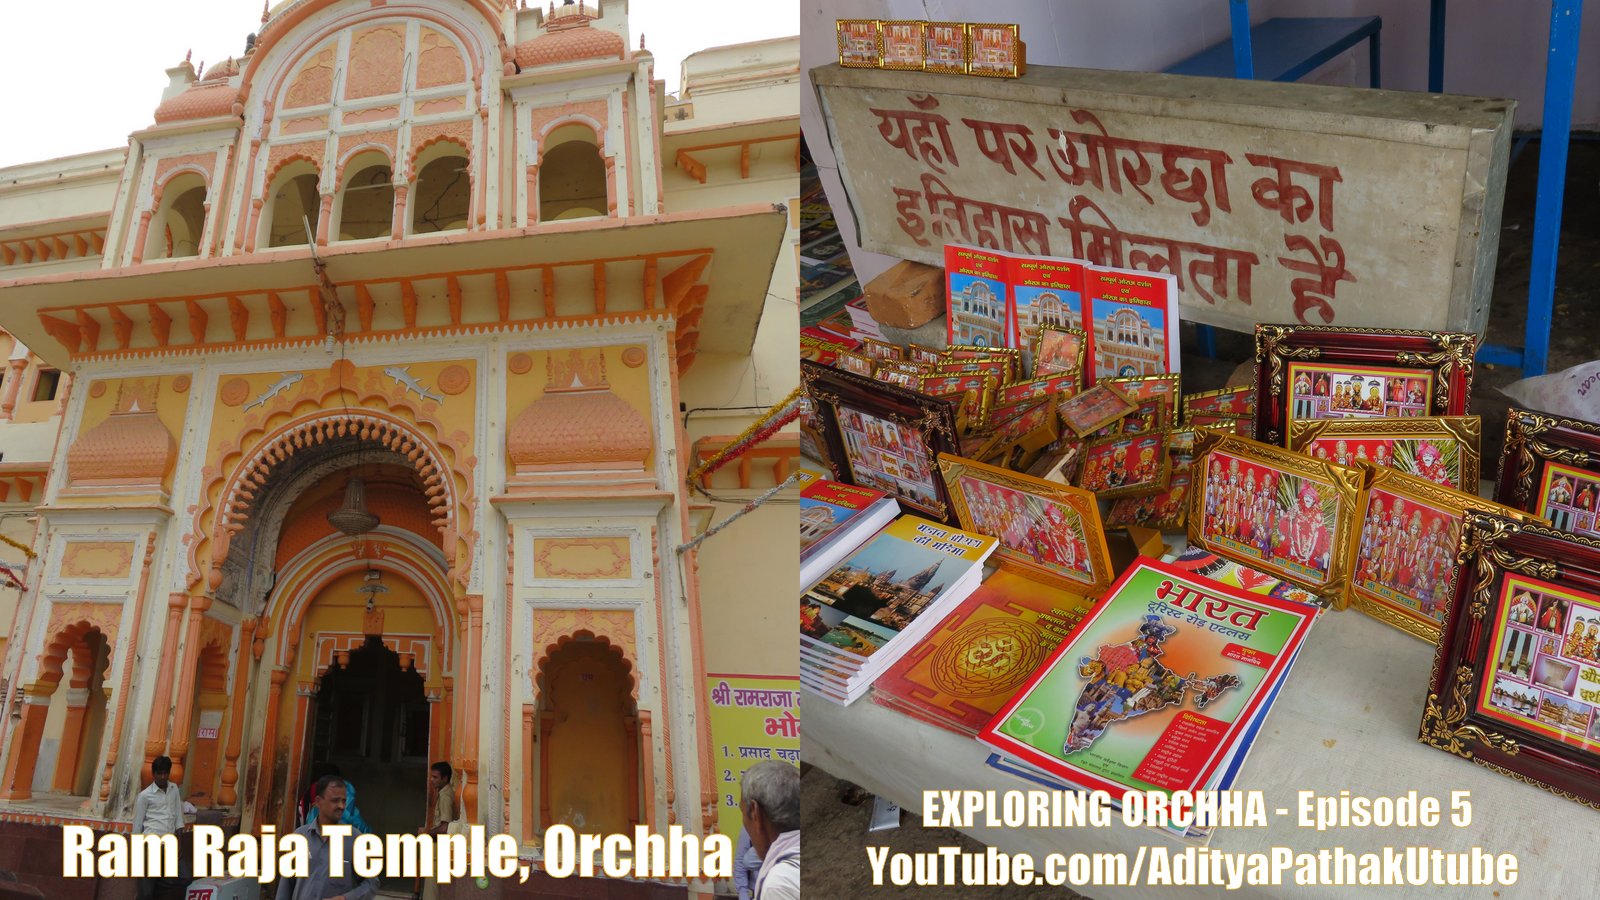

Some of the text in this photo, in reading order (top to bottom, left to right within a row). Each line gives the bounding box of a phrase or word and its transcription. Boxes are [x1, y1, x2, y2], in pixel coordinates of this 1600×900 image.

[961, 117, 1046, 182] पर
[1245, 152, 1344, 232] का
[1057, 195, 1259, 305] मिलता
[1277, 233, 1358, 325] है
[1156, 580, 1270, 631] भारत
[1147, 600, 1184, 619] टूरिस्ट
[1208, 622, 1252, 641] एटलस
[712, 681, 731, 706] श्री
[733, 689, 793, 708] रामराजा
[765, 710, 800, 738] भो
[722, 746, 734, 758] 1.
[738, 746, 772, 760] प्रसाद
[724, 769, 736, 782] 2.
[726, 794, 738, 807] 3.
